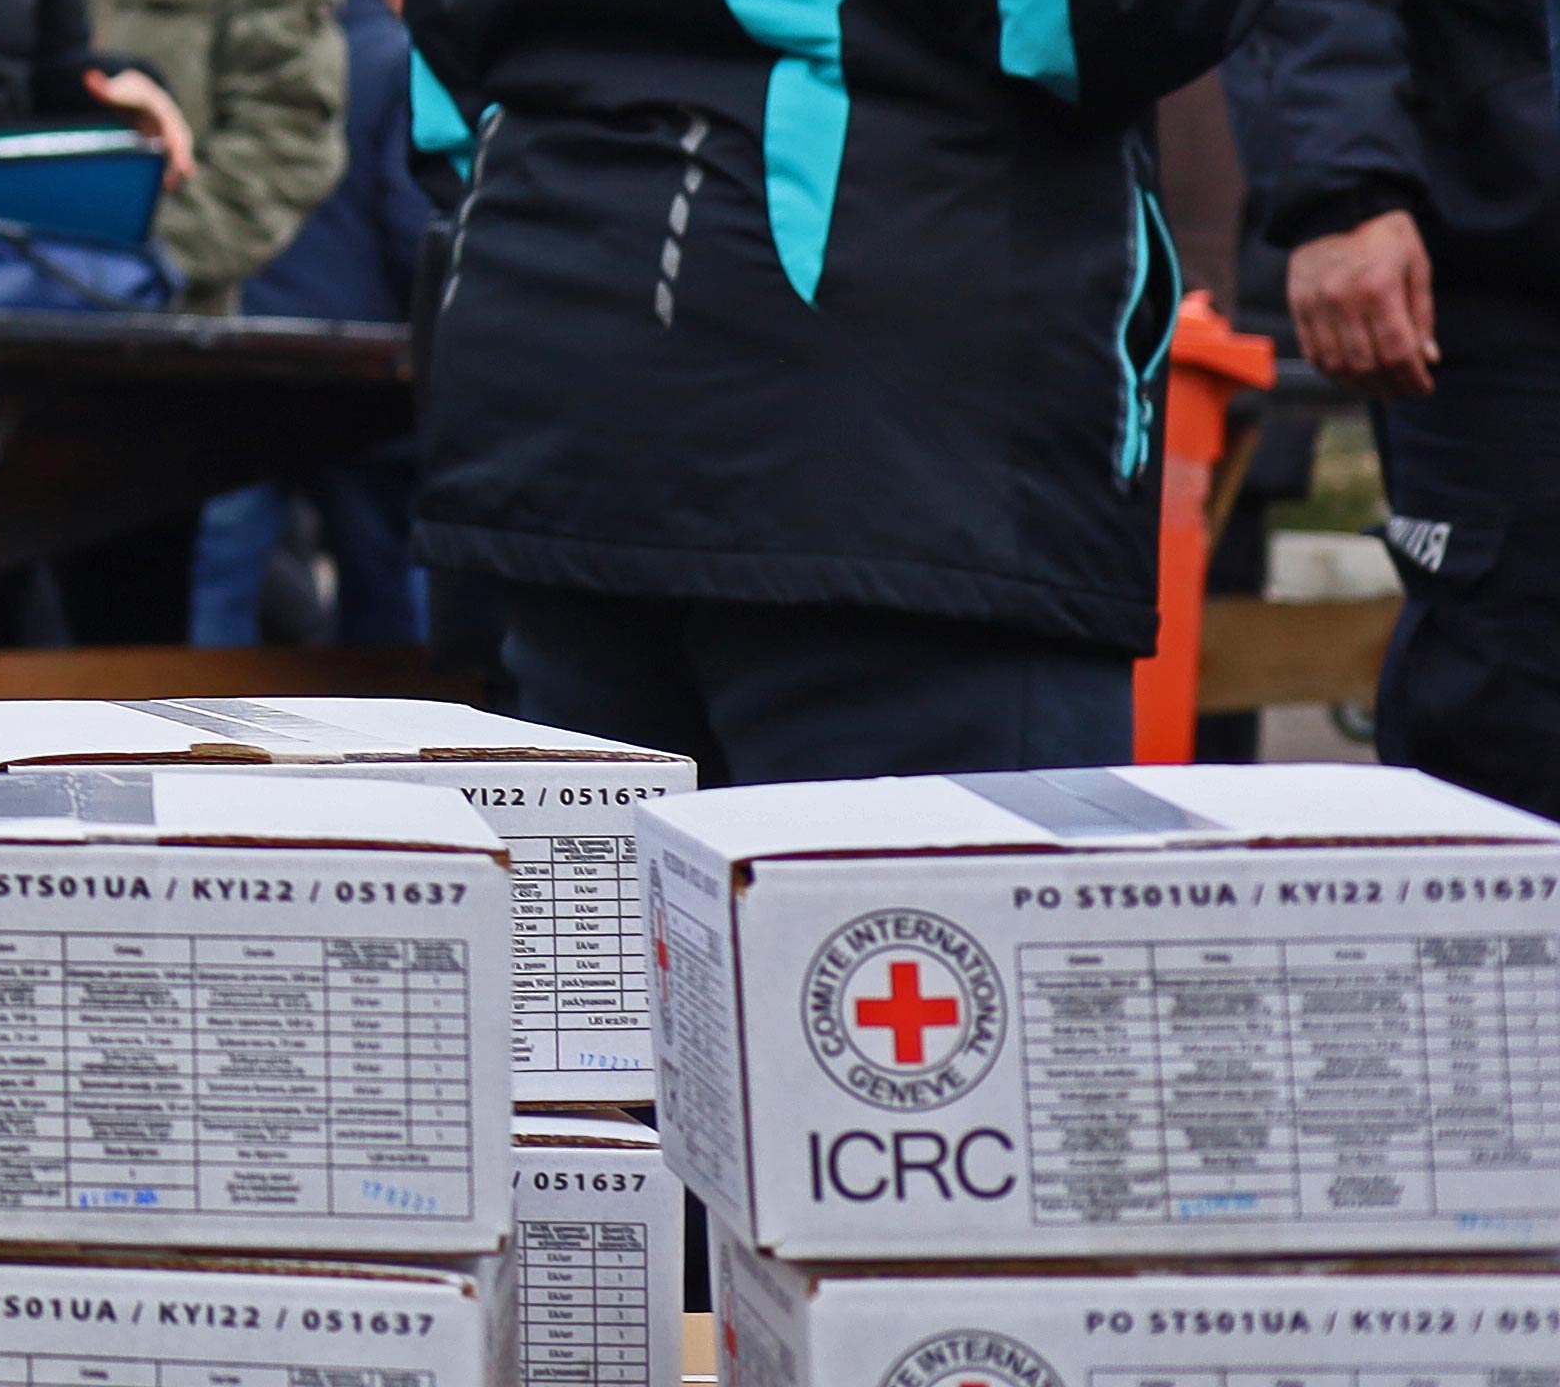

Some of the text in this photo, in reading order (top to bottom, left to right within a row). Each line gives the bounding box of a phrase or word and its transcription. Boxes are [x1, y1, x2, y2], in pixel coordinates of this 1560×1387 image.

[460, 787, 526, 806] YI22
[166, 880, 177, 900] /
[192, 879, 293, 902] KYI22
[309, 882, 319, 902] /
[335, 881, 467, 905] 051637
[1013, 886, 1062, 910] PO
[1278, 881, 1382, 904] KYI22
[1424, 877, 1557, 902] 051637
[808, 1126, 1016, 1203] ICRC
[533, 1171, 647, 1193] 051637
[131, 1304, 142, 1324] /
[158, 1303, 260, 1329] KYI22
[276, 1309, 287, 1329] /
[302, 1309, 434, 1336] 051637
[1085, 1311, 1134, 1334] PO
[1351, 1310, 1455, 1334] KYI22
[1498, 1310, 1560, 1333] 051
